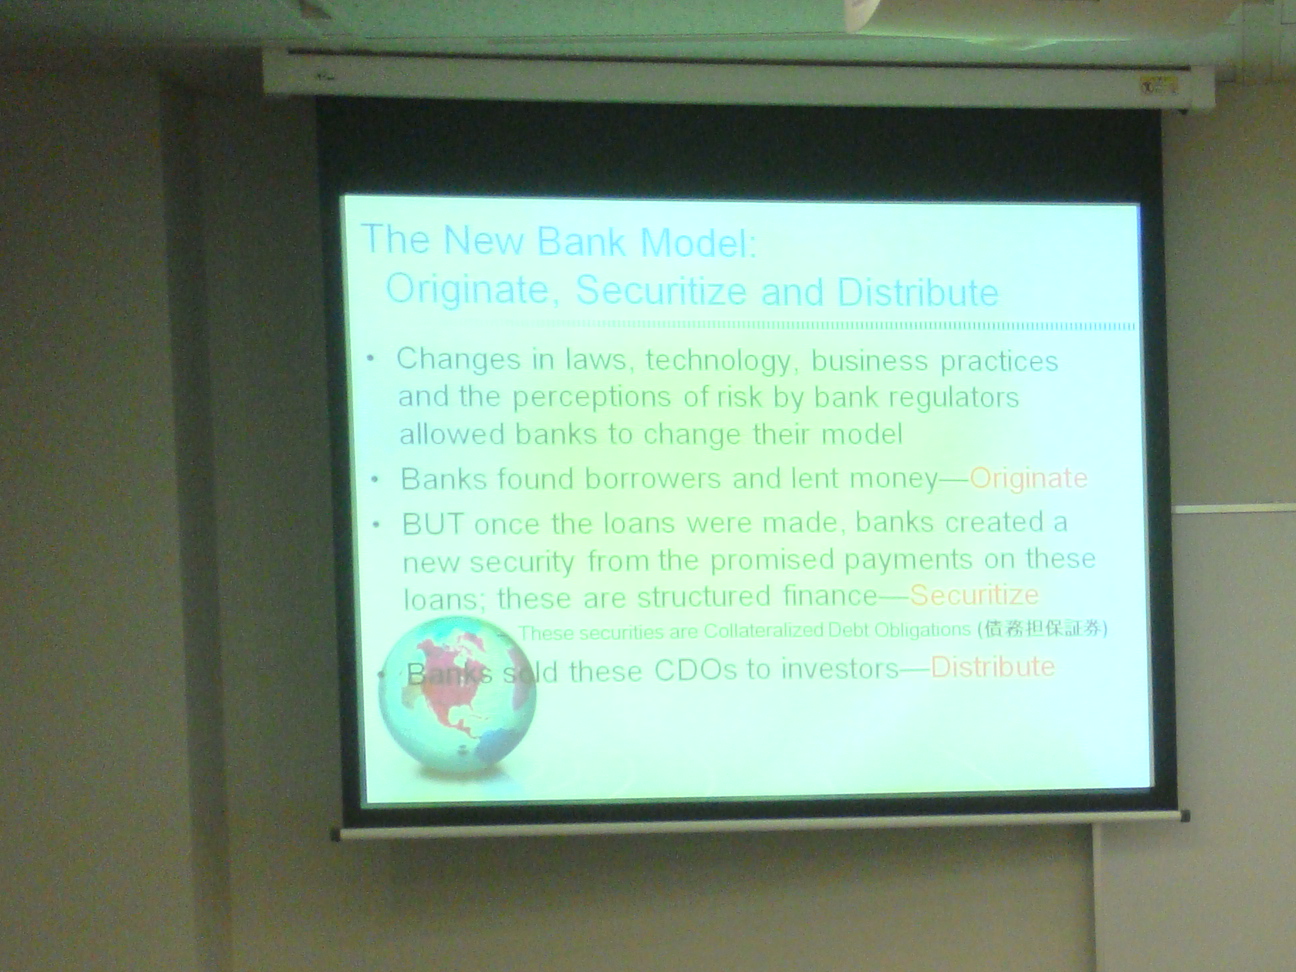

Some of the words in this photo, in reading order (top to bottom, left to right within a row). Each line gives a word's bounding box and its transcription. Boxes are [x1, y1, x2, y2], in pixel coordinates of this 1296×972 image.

[361, 223, 430, 255] The
[445, 225, 525, 256] New
[538, 226, 627, 257] Bank
[641, 228, 757, 258] Model:
[387, 272, 560, 310] Originate,
[577, 274, 747, 306] Securitize
[762, 278, 824, 307] and
[839, 277, 999, 307] Distribute
[397, 346, 521, 376] Changes
[533, 347, 554, 370] in
[566, 347, 634, 374] laws,
[646, 348, 798, 377] technology,
[812, 349, 928, 372] business
[941, 349, 1059, 377] practices
[399, 385, 448, 408] and
[459, 385, 500, 407] the
[513, 385, 671, 413] perceptions
[684, 385, 710, 408] of
[717, 385, 762, 408] risk
[774, 385, 804, 413] by
[815, 386, 879, 408] bank
[890, 386, 1020, 414] regulators
[400, 422, 504, 446] allowed
[516, 423, 598, 445] banks
[609, 424, 633, 445] to
[644, 423, 741, 451] change
[753, 423, 809, 445] their
[822, 422, 903, 446] model
[402, 467, 488, 491] Banks
[499, 467, 573, 490] found
[586, 467, 721, 490] borrowers
[733, 467, 781, 490] and
[792, 467, 839, 489] lent
[404, 512, 464, 535] BUT
[474, 516, 540, 535] once
[552, 512, 592, 534] the
[605, 512, 675, 534] loans
[687, 515, 752, 533] were
[763, 511, 846, 536] made,
[856, 510, 934, 533] banks
[946, 510, 1043, 532] created
[1054, 515, 1068, 532] a
[404, 554, 460, 573] new
[470, 549, 574, 578] security
[589, 549, 649, 573] from
[658, 549, 699, 571] the
[711, 547, 834, 576] promised
[845, 548, 973, 575] payments
[984, 550, 1015, 569] on
[1026, 547, 1096, 569] these
[404, 588, 486, 614] loans;
[499, 587, 571, 609] these
[584, 590, 626, 608] are
[638, 585, 771, 609] structured
[519, 625, 574, 641] These
[580, 624, 664, 640] securities
[669, 627, 698, 640] are
[704, 622, 824, 639] Collateralized
[829, 622, 868, 638] Debt
[875, 621, 971, 640] Obligations
[407, 661, 492, 686] Banks
[503, 660, 558, 684] sold
[570, 660, 643, 683] these
[655, 658, 737, 682] CDOs
[747, 658, 770, 681] to
